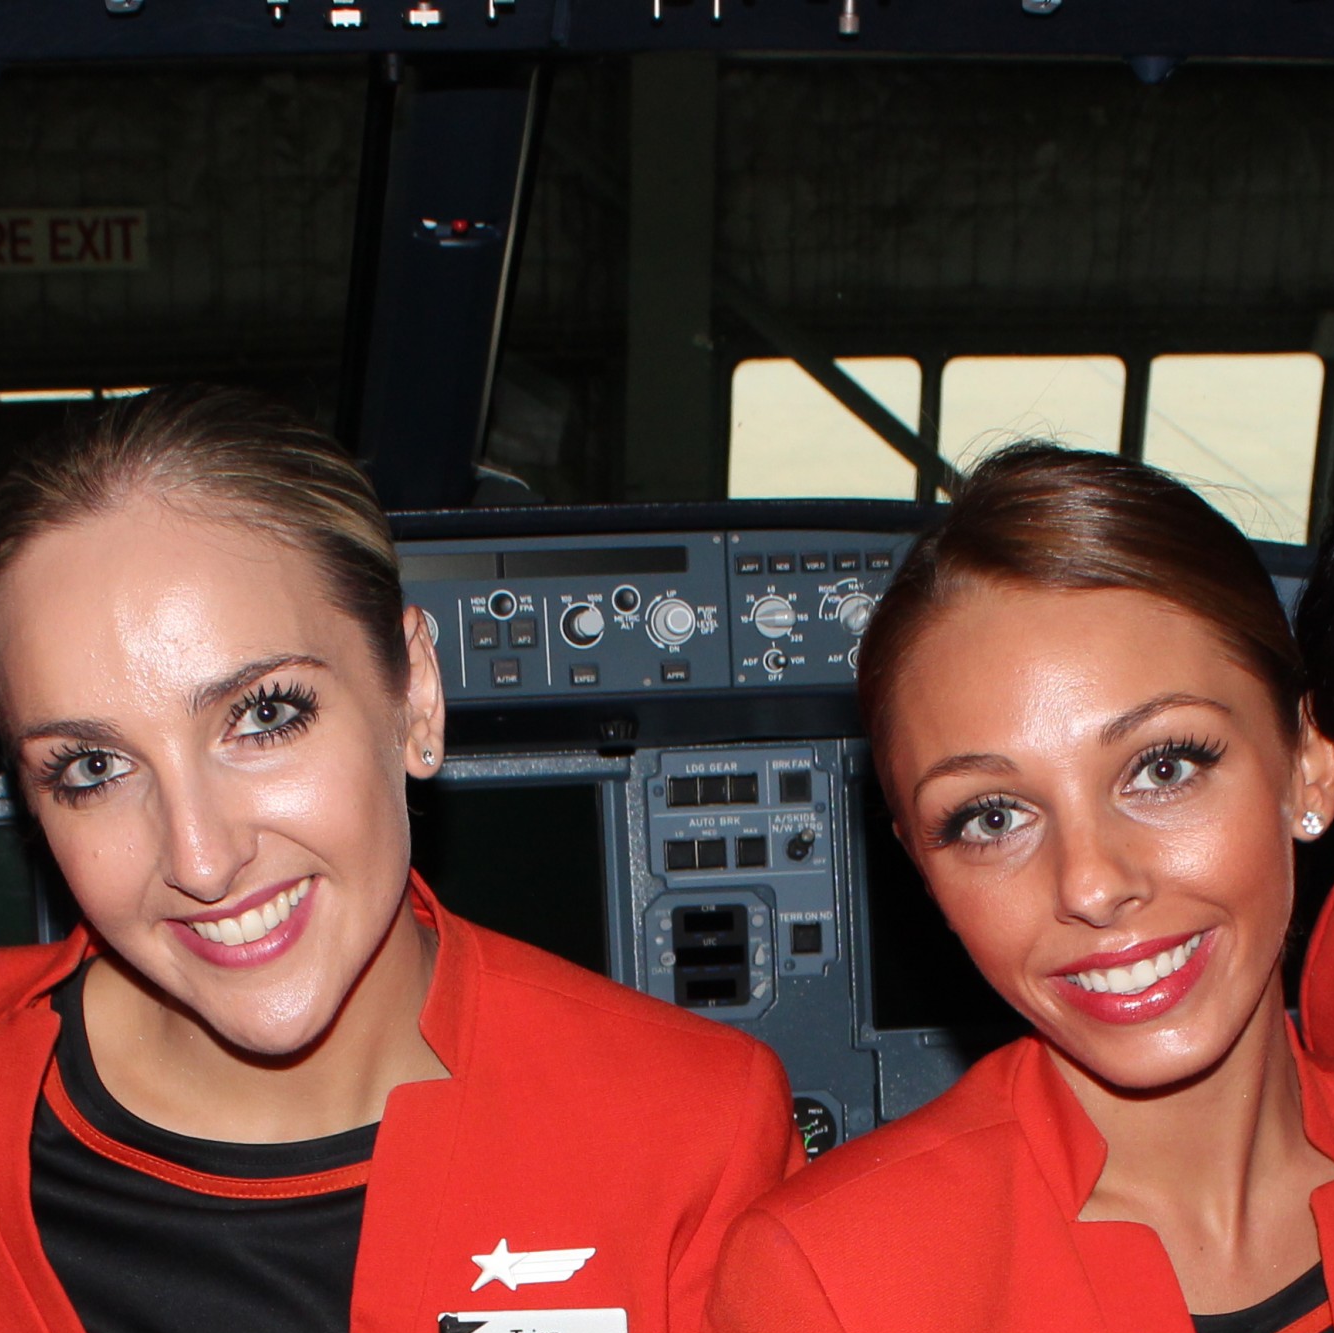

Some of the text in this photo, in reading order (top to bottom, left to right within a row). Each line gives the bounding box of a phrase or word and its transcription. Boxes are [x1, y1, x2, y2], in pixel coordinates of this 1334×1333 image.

[47, 216, 140, 263] EXIT
[741, 564, 759, 572] ARPT
[841, 561, 856, 569] WPT
[848, 583, 864, 591] NAV
[587, 594, 603, 602] 1000
[666, 590, 677, 598] UP
[471, 606, 486, 614] TRK
[519, 604, 534, 612] FPA
[697, 606, 717, 614] PUSH
[614, 614, 640, 622] METRIC
[741, 615, 749, 623] 10
[797, 614, 809, 622] 160
[621, 622, 635, 630] ALT
[697, 620, 718, 628] LEVEL
[518, 636, 531, 644] AP2
[791, 634, 803, 643] 320
[743, 658, 759, 667] ADF
[791, 656, 805, 665] VOR
[828, 655, 843, 663] ADF
[496, 675, 517, 683] A/THR
[574, 675, 595, 683] EXPED
[667, 672, 685, 680] APPR
[768, 674, 783, 682] OFF
[685, 762, 738, 773] LDG GEAR
[772, 760, 811, 770] BRK FAN
[689, 816, 741, 827] AUTO BRK
[772, 823, 792, 833] N/W
[779, 911, 833, 922] TERR ON ND
[703, 938, 717, 946] UTC
